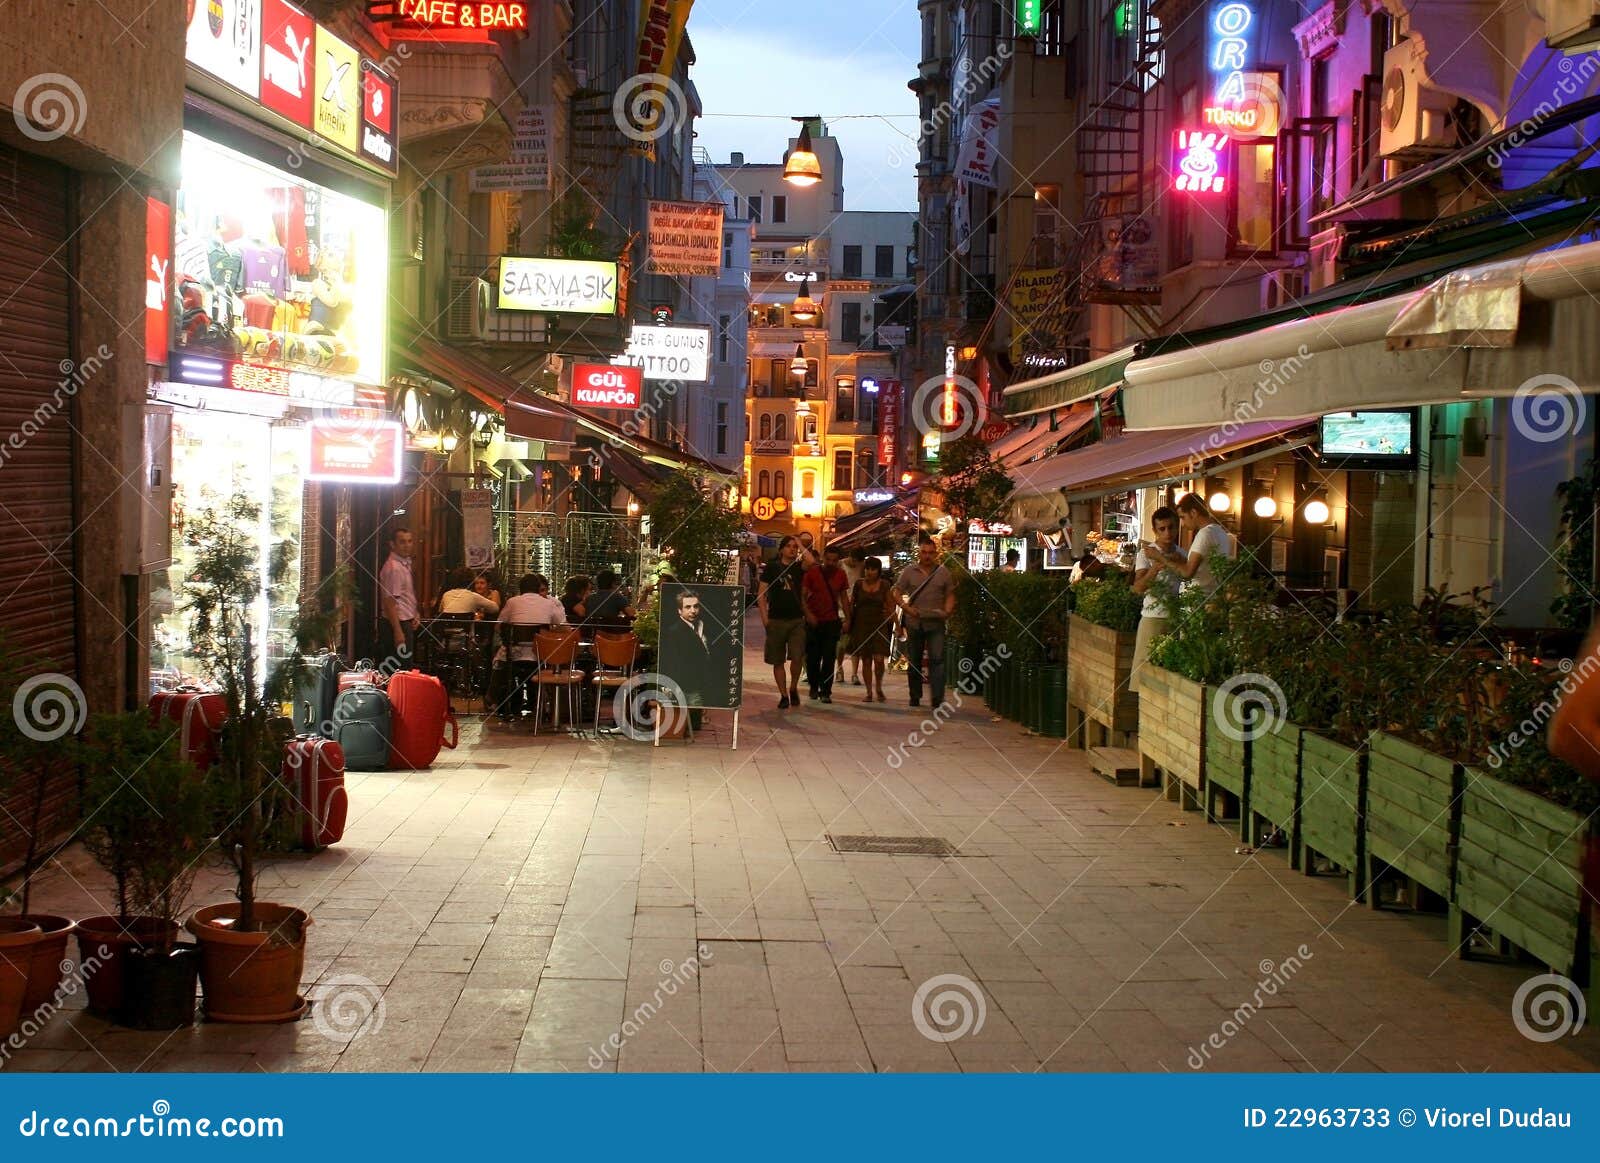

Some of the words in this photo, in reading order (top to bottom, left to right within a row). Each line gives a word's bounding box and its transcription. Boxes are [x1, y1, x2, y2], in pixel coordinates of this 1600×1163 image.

[400, 0, 456, 24] CAFE
[460, 5, 475, 27] &
[480, 4, 523, 26] BAR
[627, 354, 690, 374] TATTOO
[588, 371, 626, 388] GÜL
[577, 389, 635, 404] KUAFÖR
[882, 382, 895, 463] INTERNET
